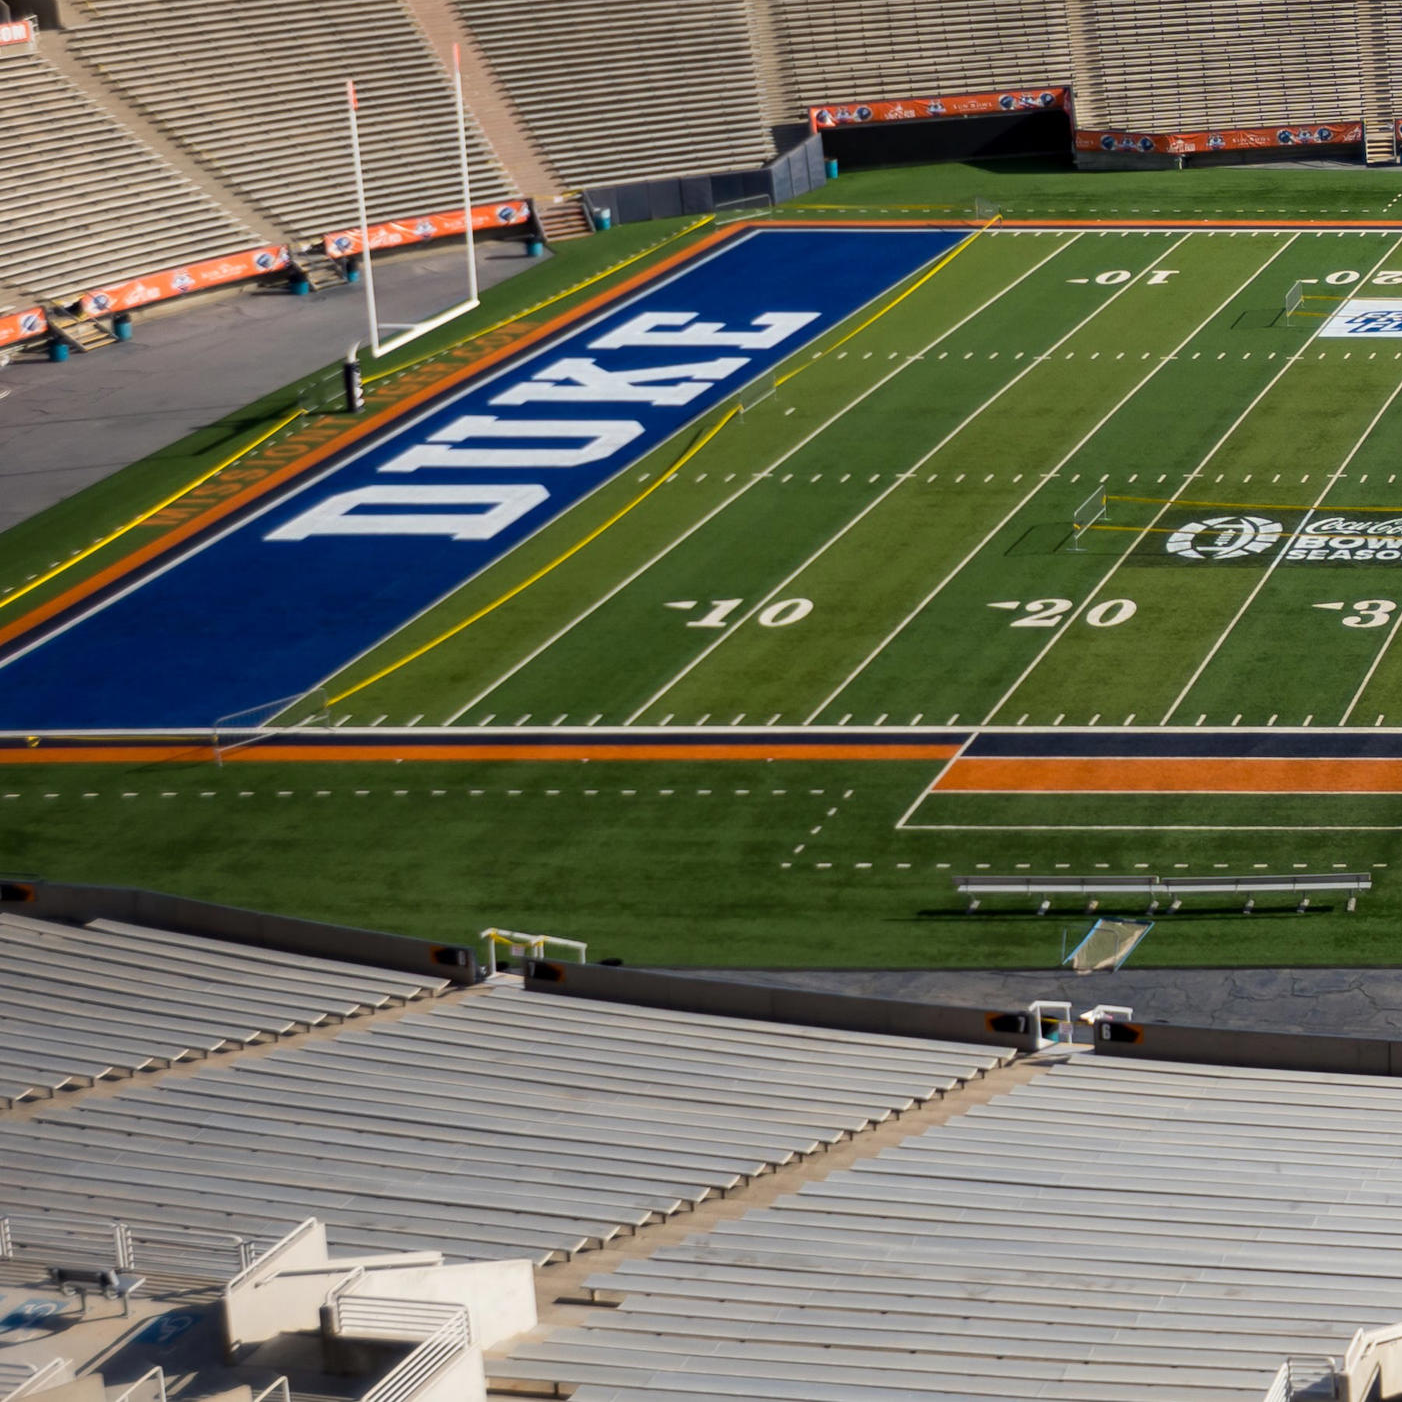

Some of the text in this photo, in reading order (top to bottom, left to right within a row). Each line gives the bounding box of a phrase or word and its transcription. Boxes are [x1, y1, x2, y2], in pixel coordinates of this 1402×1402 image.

[1095, 269, 1181, 286] 10
[261, 310, 823, 542] DUKE
[683, 597, 815, 628] 10
[1009, 598, 1138, 628] 20
[1017, 1016, 1025, 1033] 7
[1101, 1024, 1111, 1041] 6
